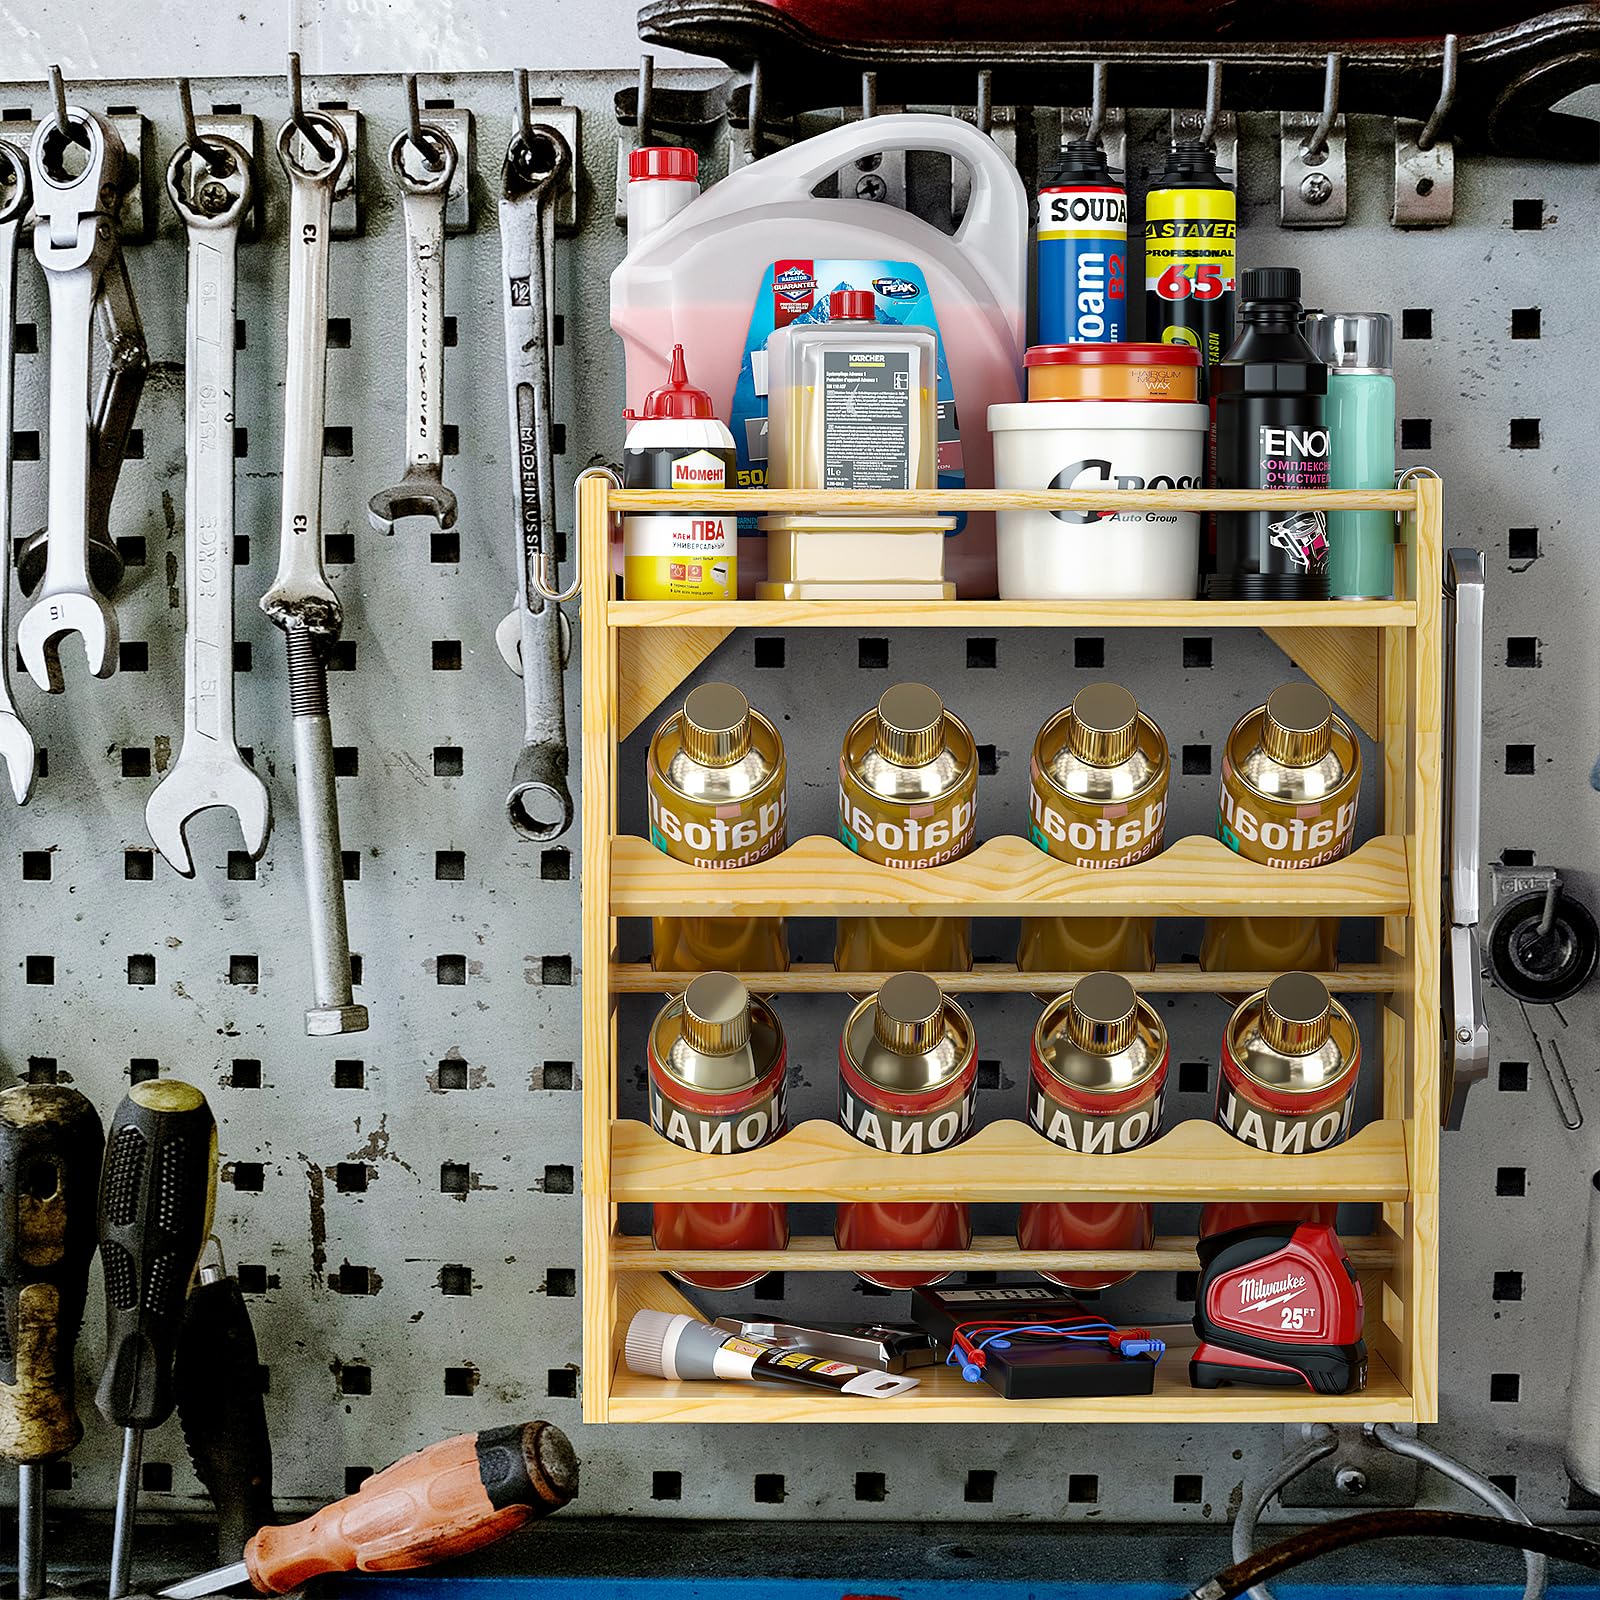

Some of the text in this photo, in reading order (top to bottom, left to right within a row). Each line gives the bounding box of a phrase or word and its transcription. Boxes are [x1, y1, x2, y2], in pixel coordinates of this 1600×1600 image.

[304, 224, 317, 245] 13
[1161, 223, 1236, 238] STAYER
[1146, 249, 1234, 258] PROFESSIONAL
[1108, 254, 1125, 300] B2
[773, 281, 816, 291] GUARANTEE
[882, 283, 917, 295] PEAK
[1145, 382, 1171, 390] WAX
[676, 465, 724, 481] Момент
[521, 427, 539, 556] MADE IN USSR
[293, 514, 307, 535] 13
[1109, 511, 1178, 524] Auto Group
[692, 520, 725, 541] ПВА
[1238, 1273, 1306, 1305] Milwaukee
